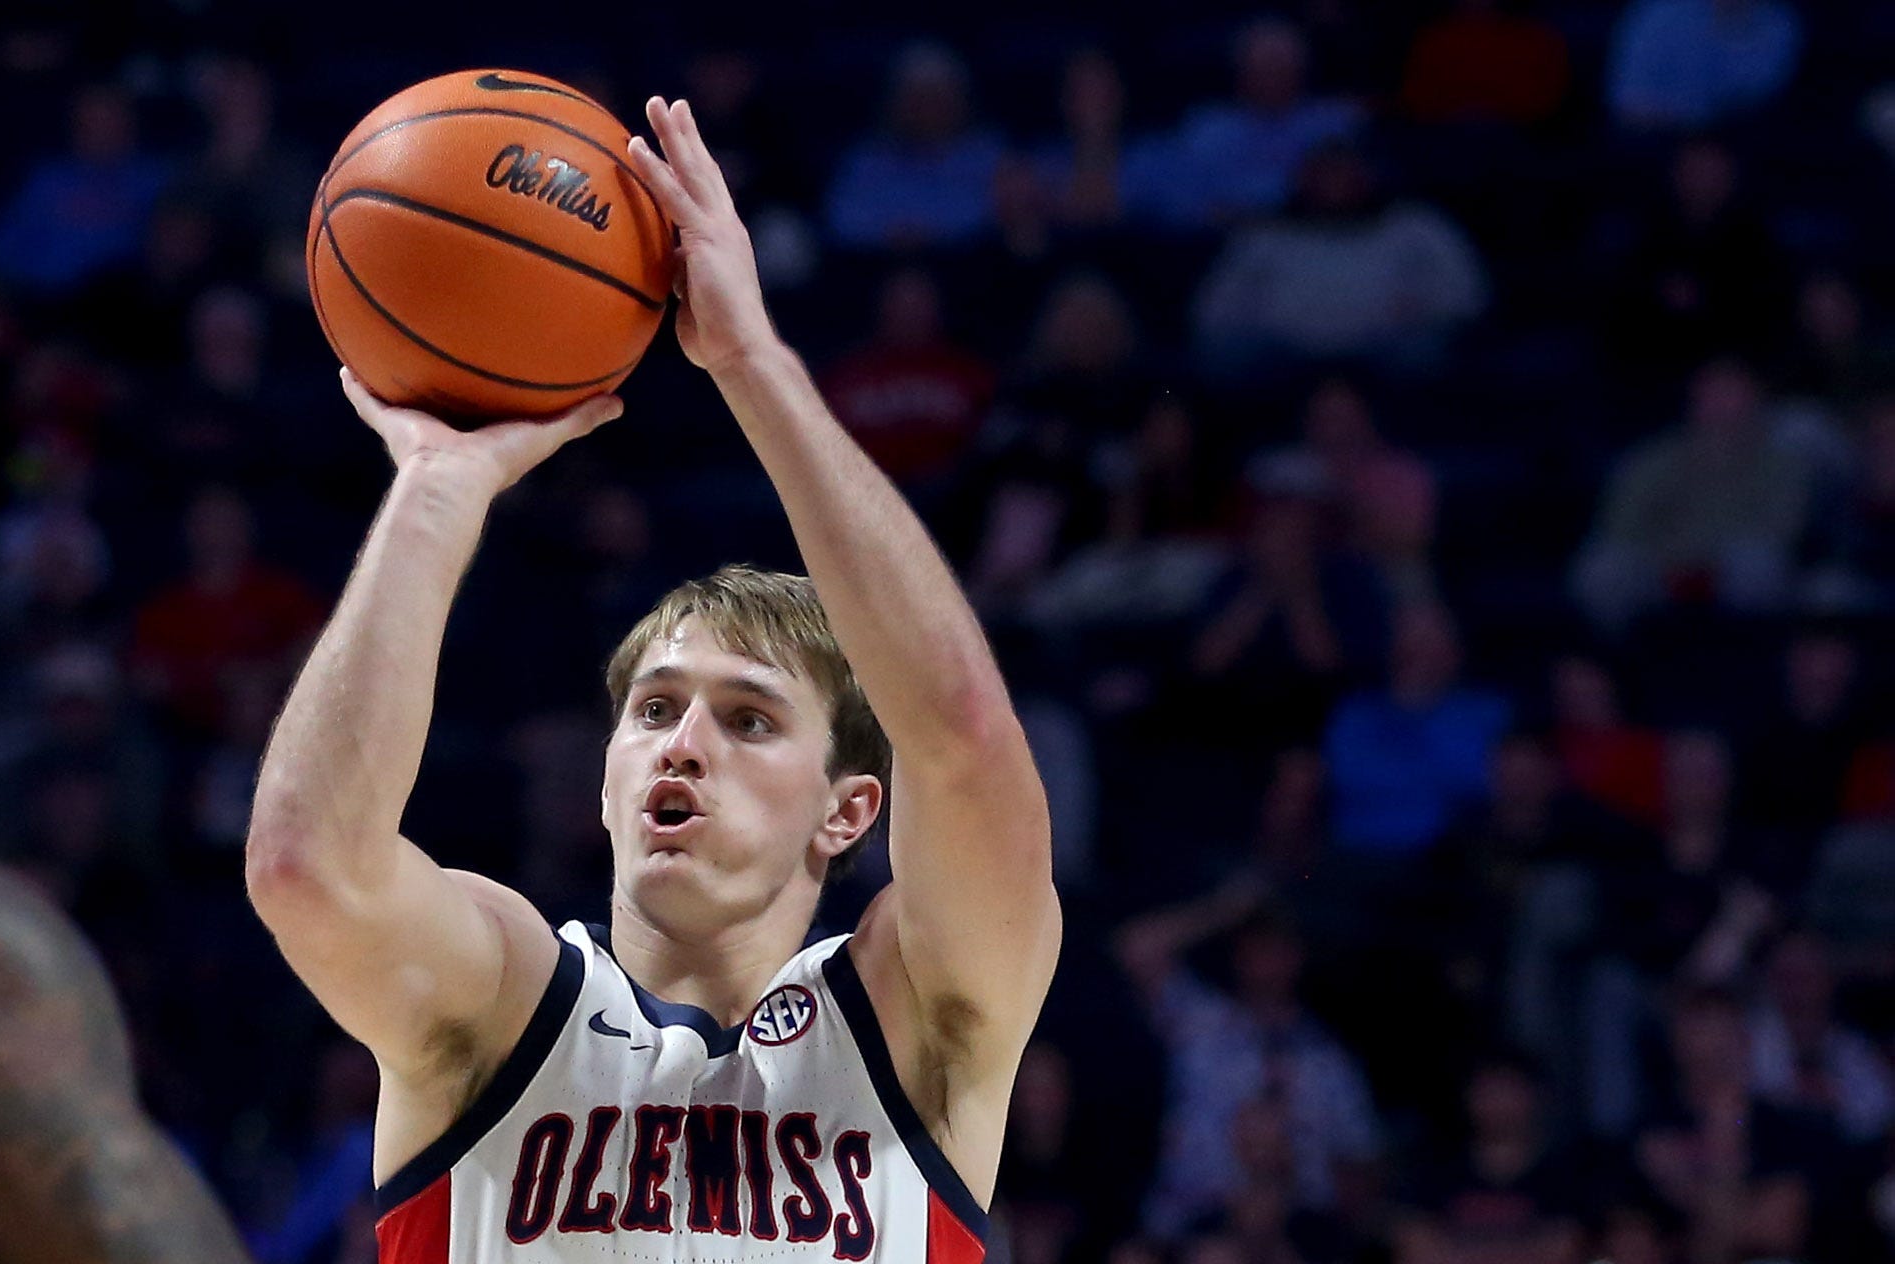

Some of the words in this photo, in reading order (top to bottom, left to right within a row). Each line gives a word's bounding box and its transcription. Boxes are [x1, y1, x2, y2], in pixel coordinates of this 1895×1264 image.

[486, 144, 542, 196] Ole
[537, 157, 612, 231] Miss
[752, 989, 811, 1042] SEC
